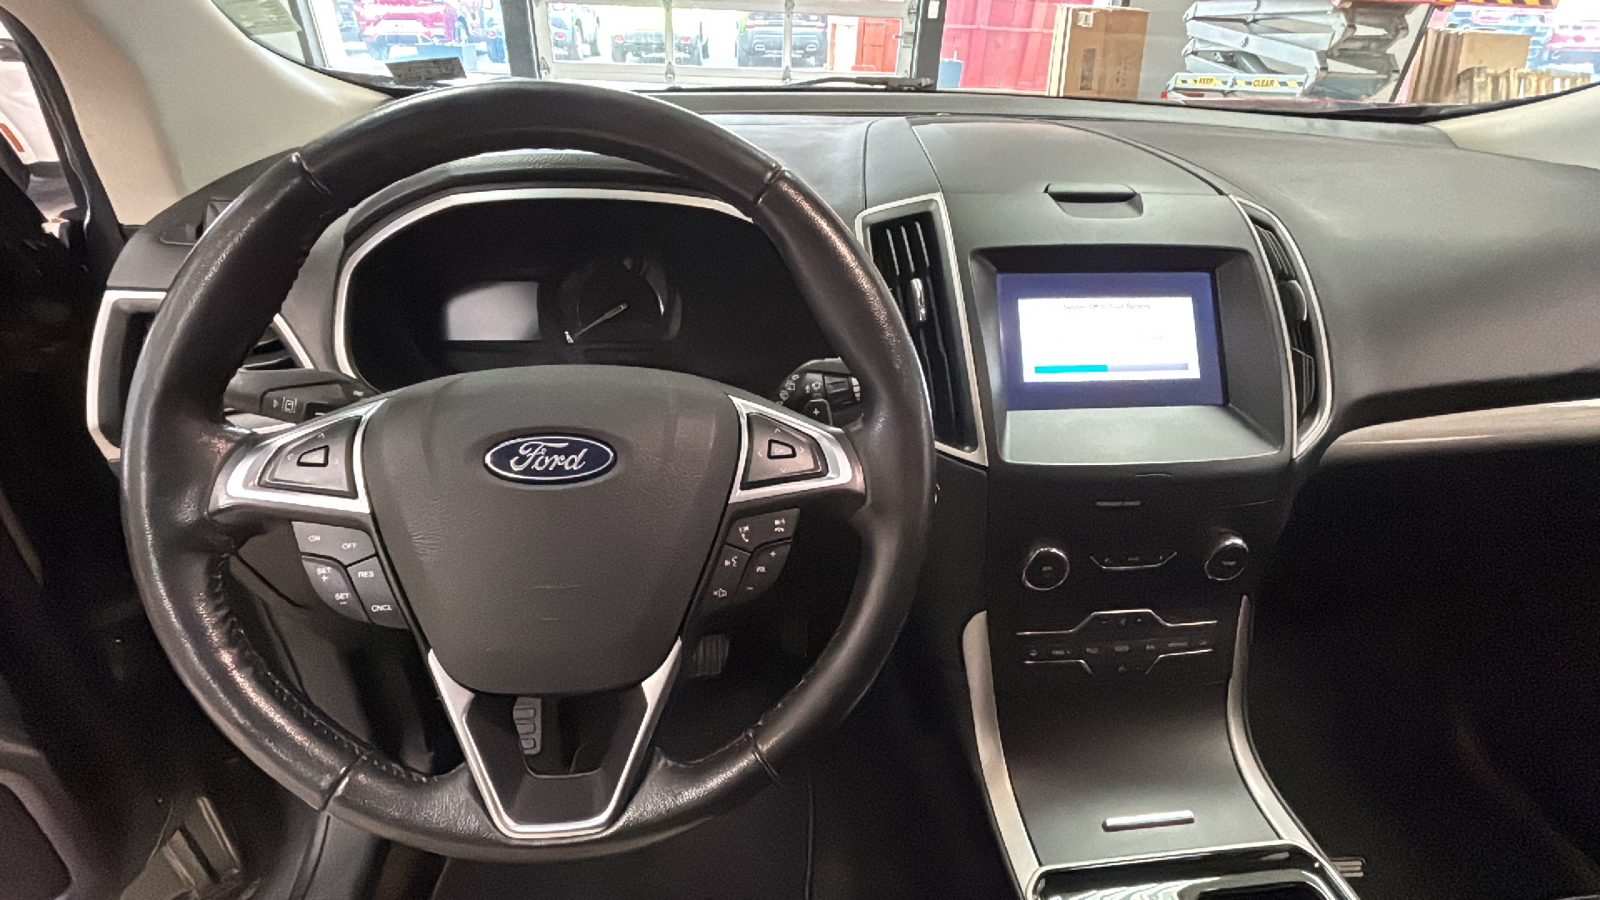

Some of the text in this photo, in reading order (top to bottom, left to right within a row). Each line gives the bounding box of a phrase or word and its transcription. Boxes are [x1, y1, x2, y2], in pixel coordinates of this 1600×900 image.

[1252, 79, 1275, 88] CLEAR
[509, 441, 588, 471] Ford
[341, 542, 357, 550] OFF
[316, 566, 331, 575] SET
[335, 592, 350, 600] SET
[371, 604, 392, 612] CNCL
